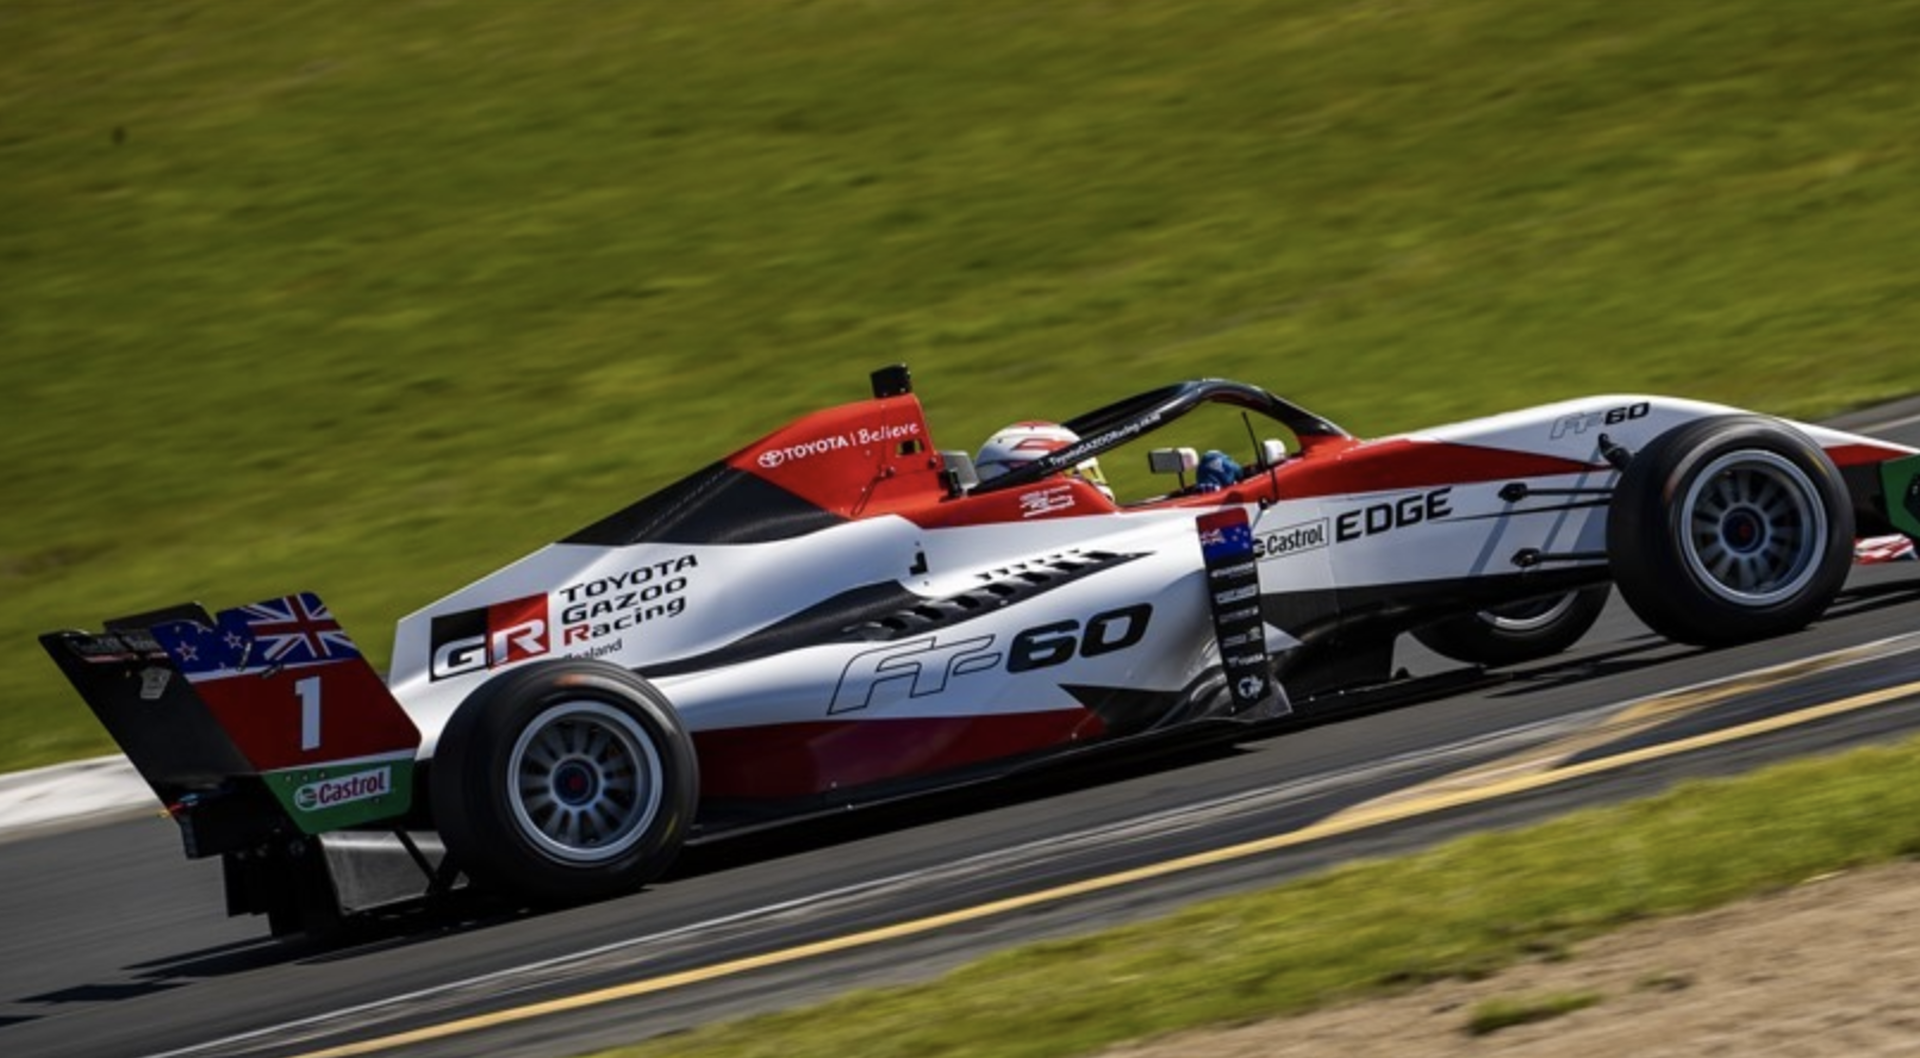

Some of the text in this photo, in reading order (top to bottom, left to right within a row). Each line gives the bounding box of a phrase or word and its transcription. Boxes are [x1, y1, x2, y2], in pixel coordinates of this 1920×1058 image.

[784, 422, 920, 461] TOYOTA Believe
[1266, 486, 1453, 555] Castrol EDGE
[559, 553, 698, 602] TOYOTA
[561, 576, 688, 625] GAZOO
[563, 595, 687, 647] Racing
[432, 618, 548, 679] GR
[294, 676, 321, 751] 1
[319, 771, 385, 804] Castrol
